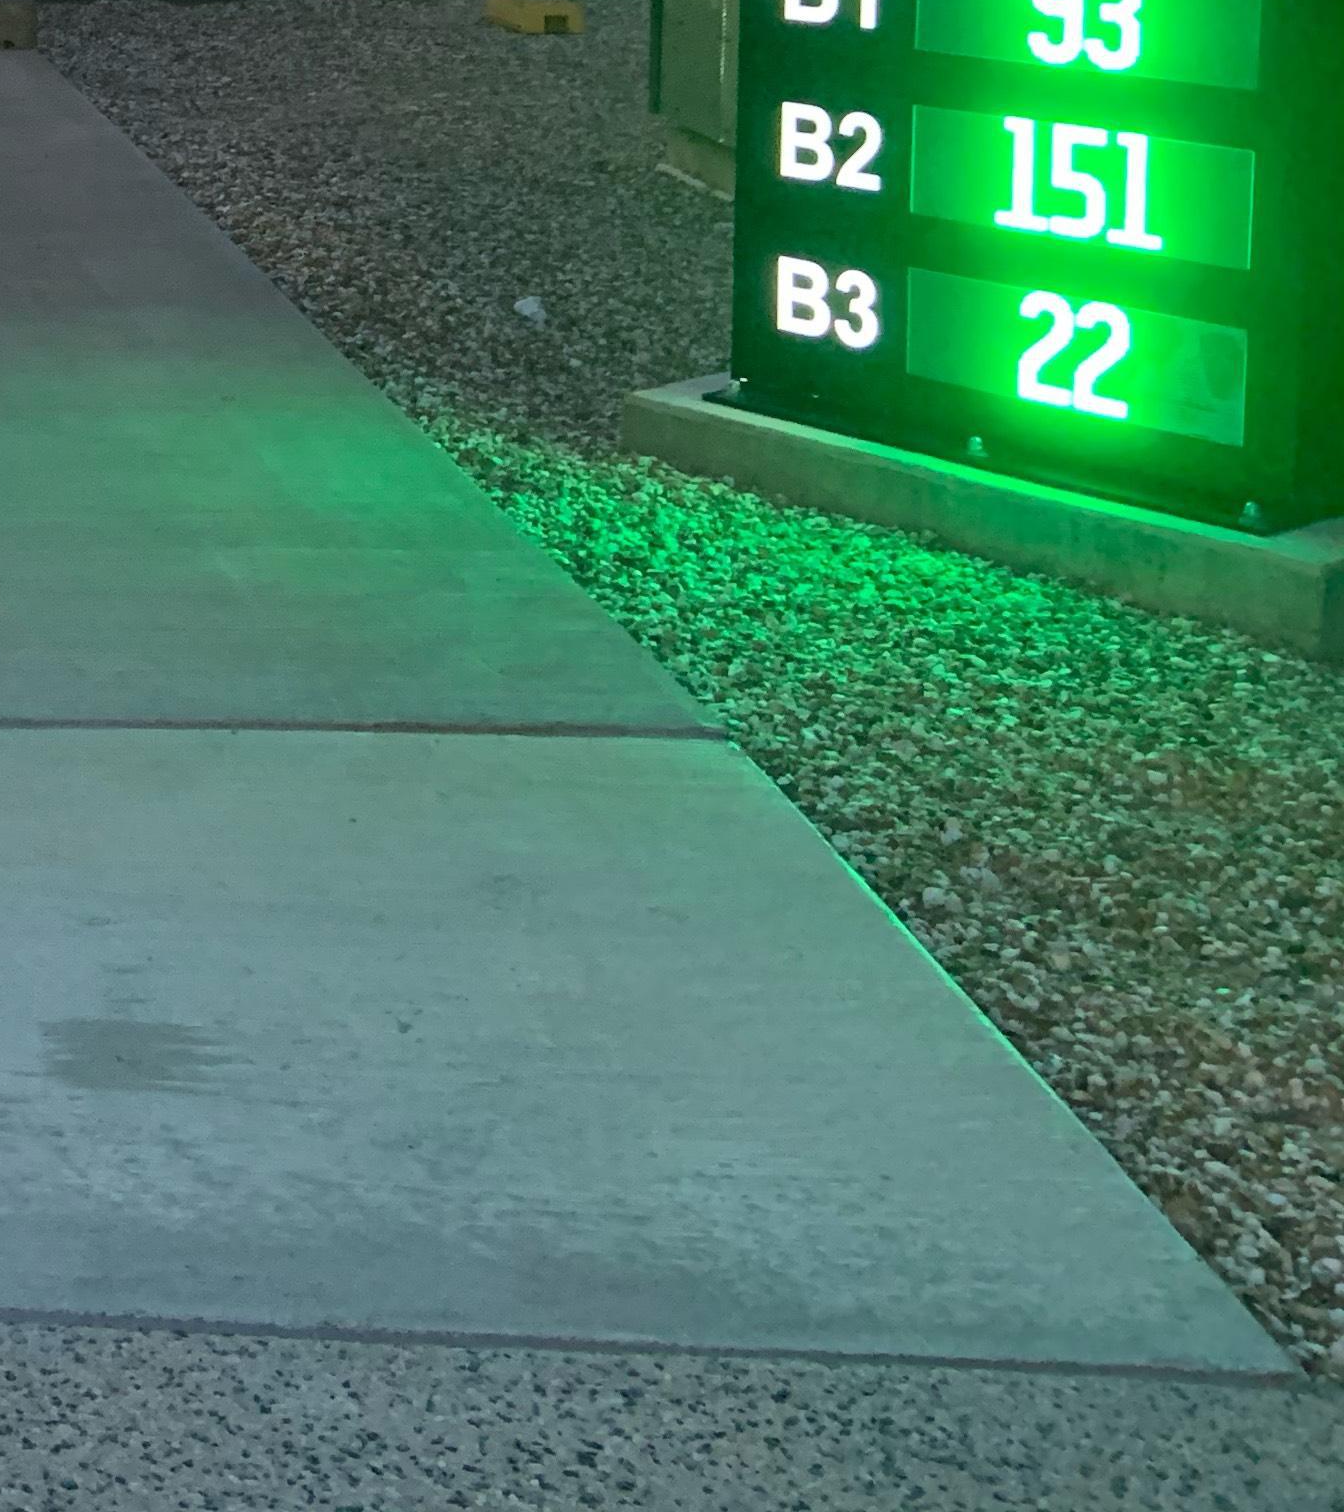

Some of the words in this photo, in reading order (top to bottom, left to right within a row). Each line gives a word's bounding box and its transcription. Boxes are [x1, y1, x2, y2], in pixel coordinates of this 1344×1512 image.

[778, 100, 884, 192] B2
[994, 114, 1163, 251] 151
[775, 255, 880, 350] B3
[1017, 289, 1132, 421] 22
